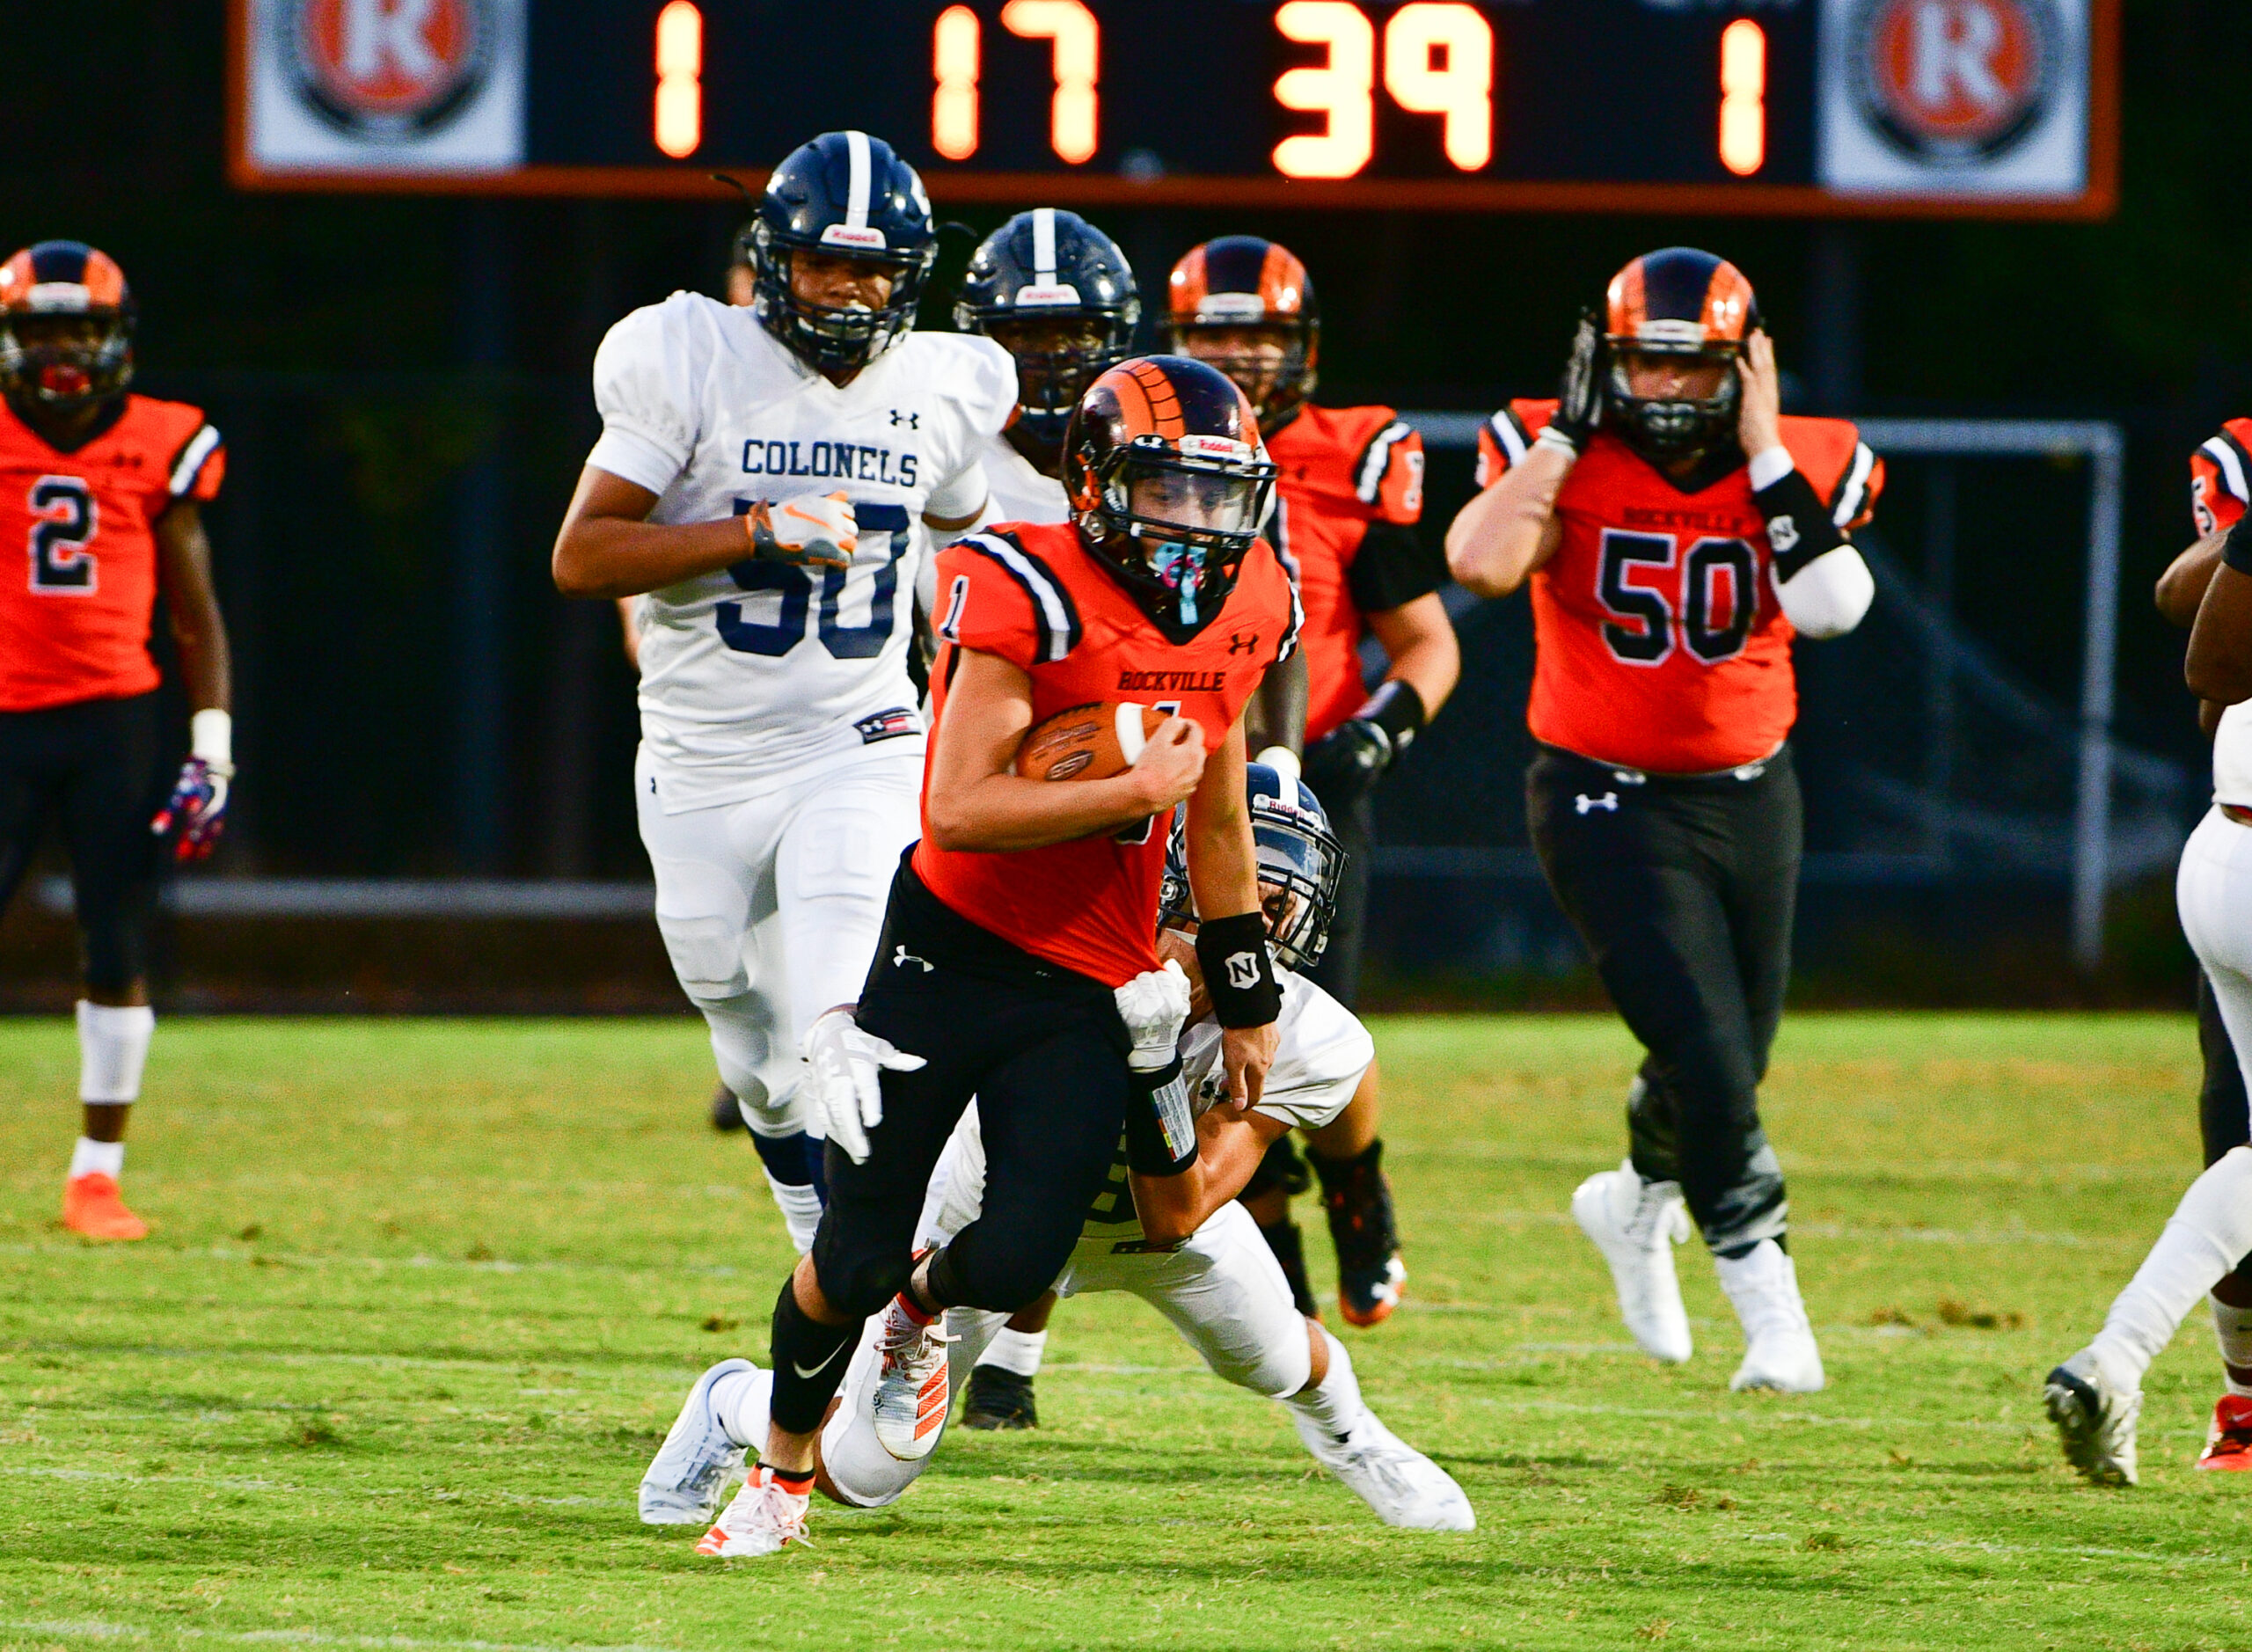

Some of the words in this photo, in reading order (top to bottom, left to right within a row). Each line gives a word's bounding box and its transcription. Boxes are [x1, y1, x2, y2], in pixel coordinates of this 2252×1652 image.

[932, 0, 1099, 164] 17
[1273, 0, 1494, 179] 39
[1719, 19, 1766, 176] 1
[741, 438, 919, 488] COLONELS
[28, 475, 98, 596] 2
[1596, 528, 1758, 669] 50
[1117, 670, 1227, 692] ROCKVILLE
[1231, 957, 1255, 983] N
